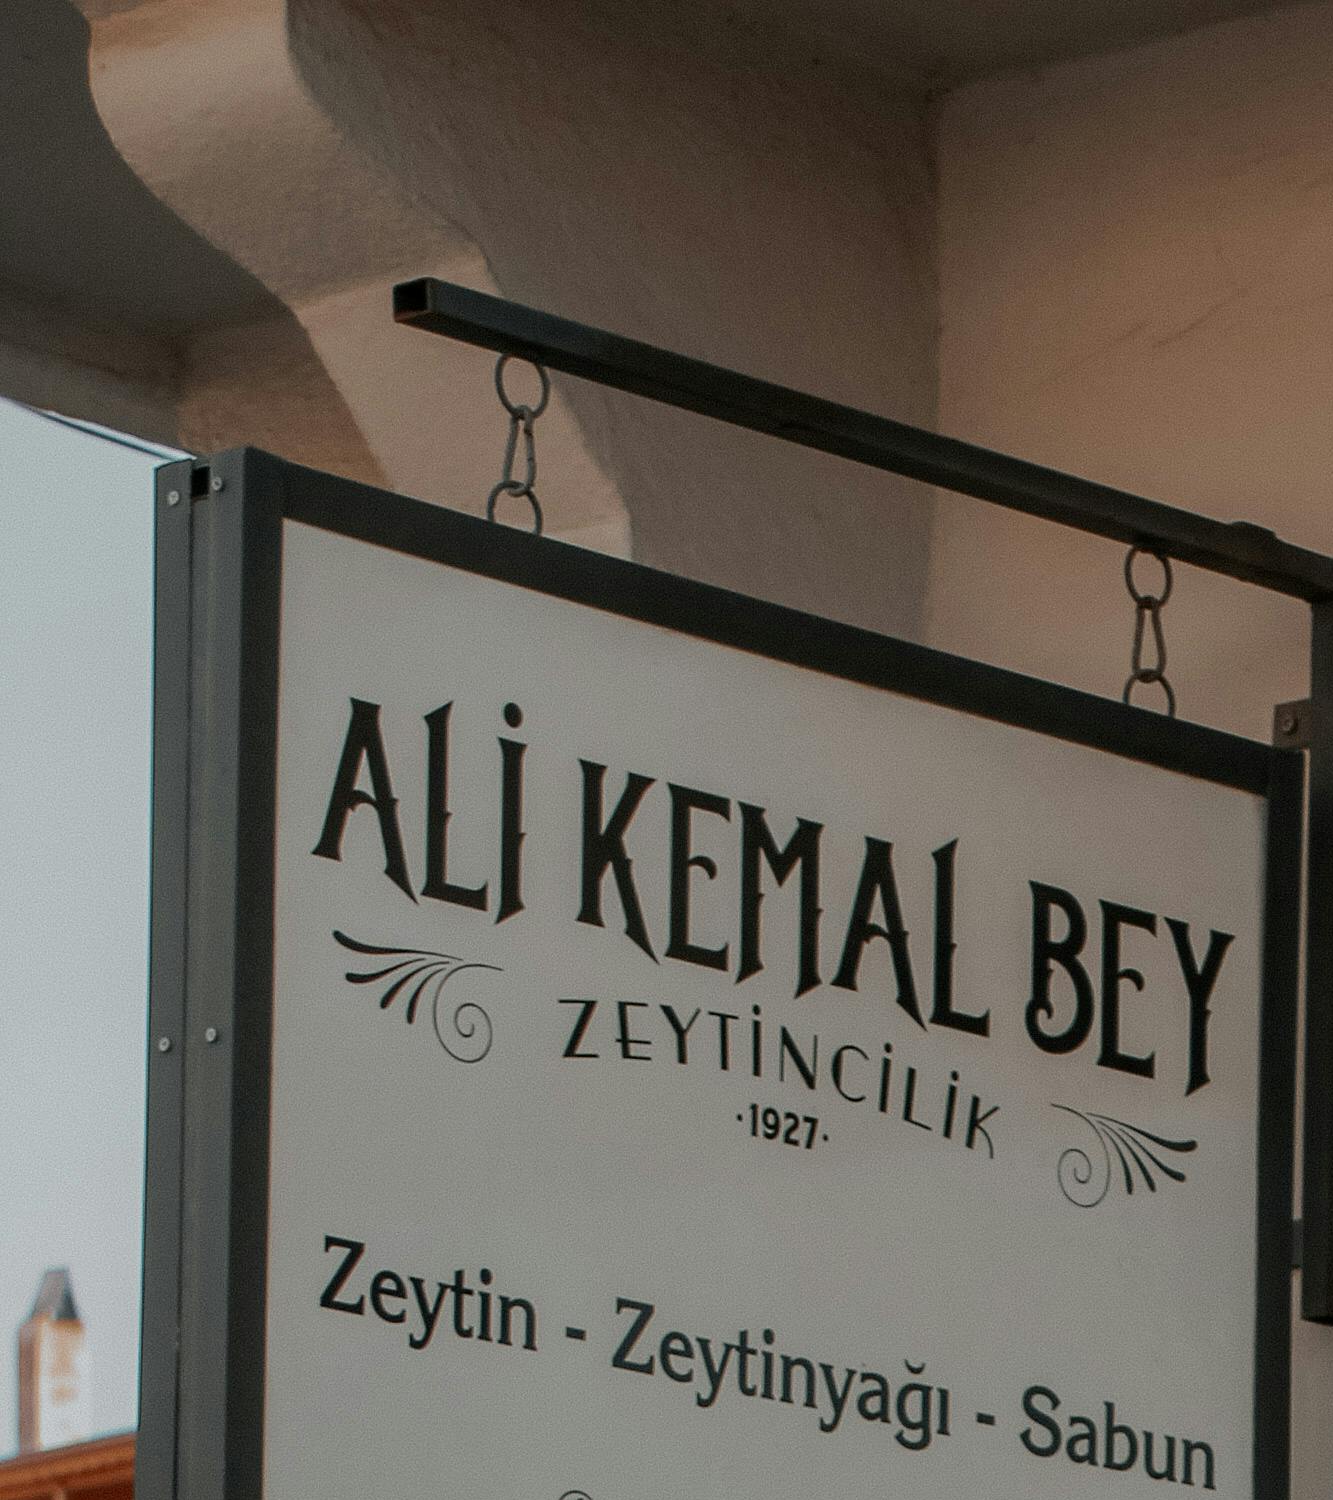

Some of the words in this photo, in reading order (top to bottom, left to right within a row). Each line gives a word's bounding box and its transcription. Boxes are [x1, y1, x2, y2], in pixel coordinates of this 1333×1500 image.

[311, 697, 529, 925] ALİ
[578, 755, 989, 1039] KEMAL
[1024, 880, 1235, 1098] BEY
[558, 997, 1001, 1160] ZEYTİNCİLİK
[319, 1234, 537, 1352] Zeytin
[611, 1299, 950, 1449] Zeytinyağı
[1020, 1385, 1215, 1491] Sabun
